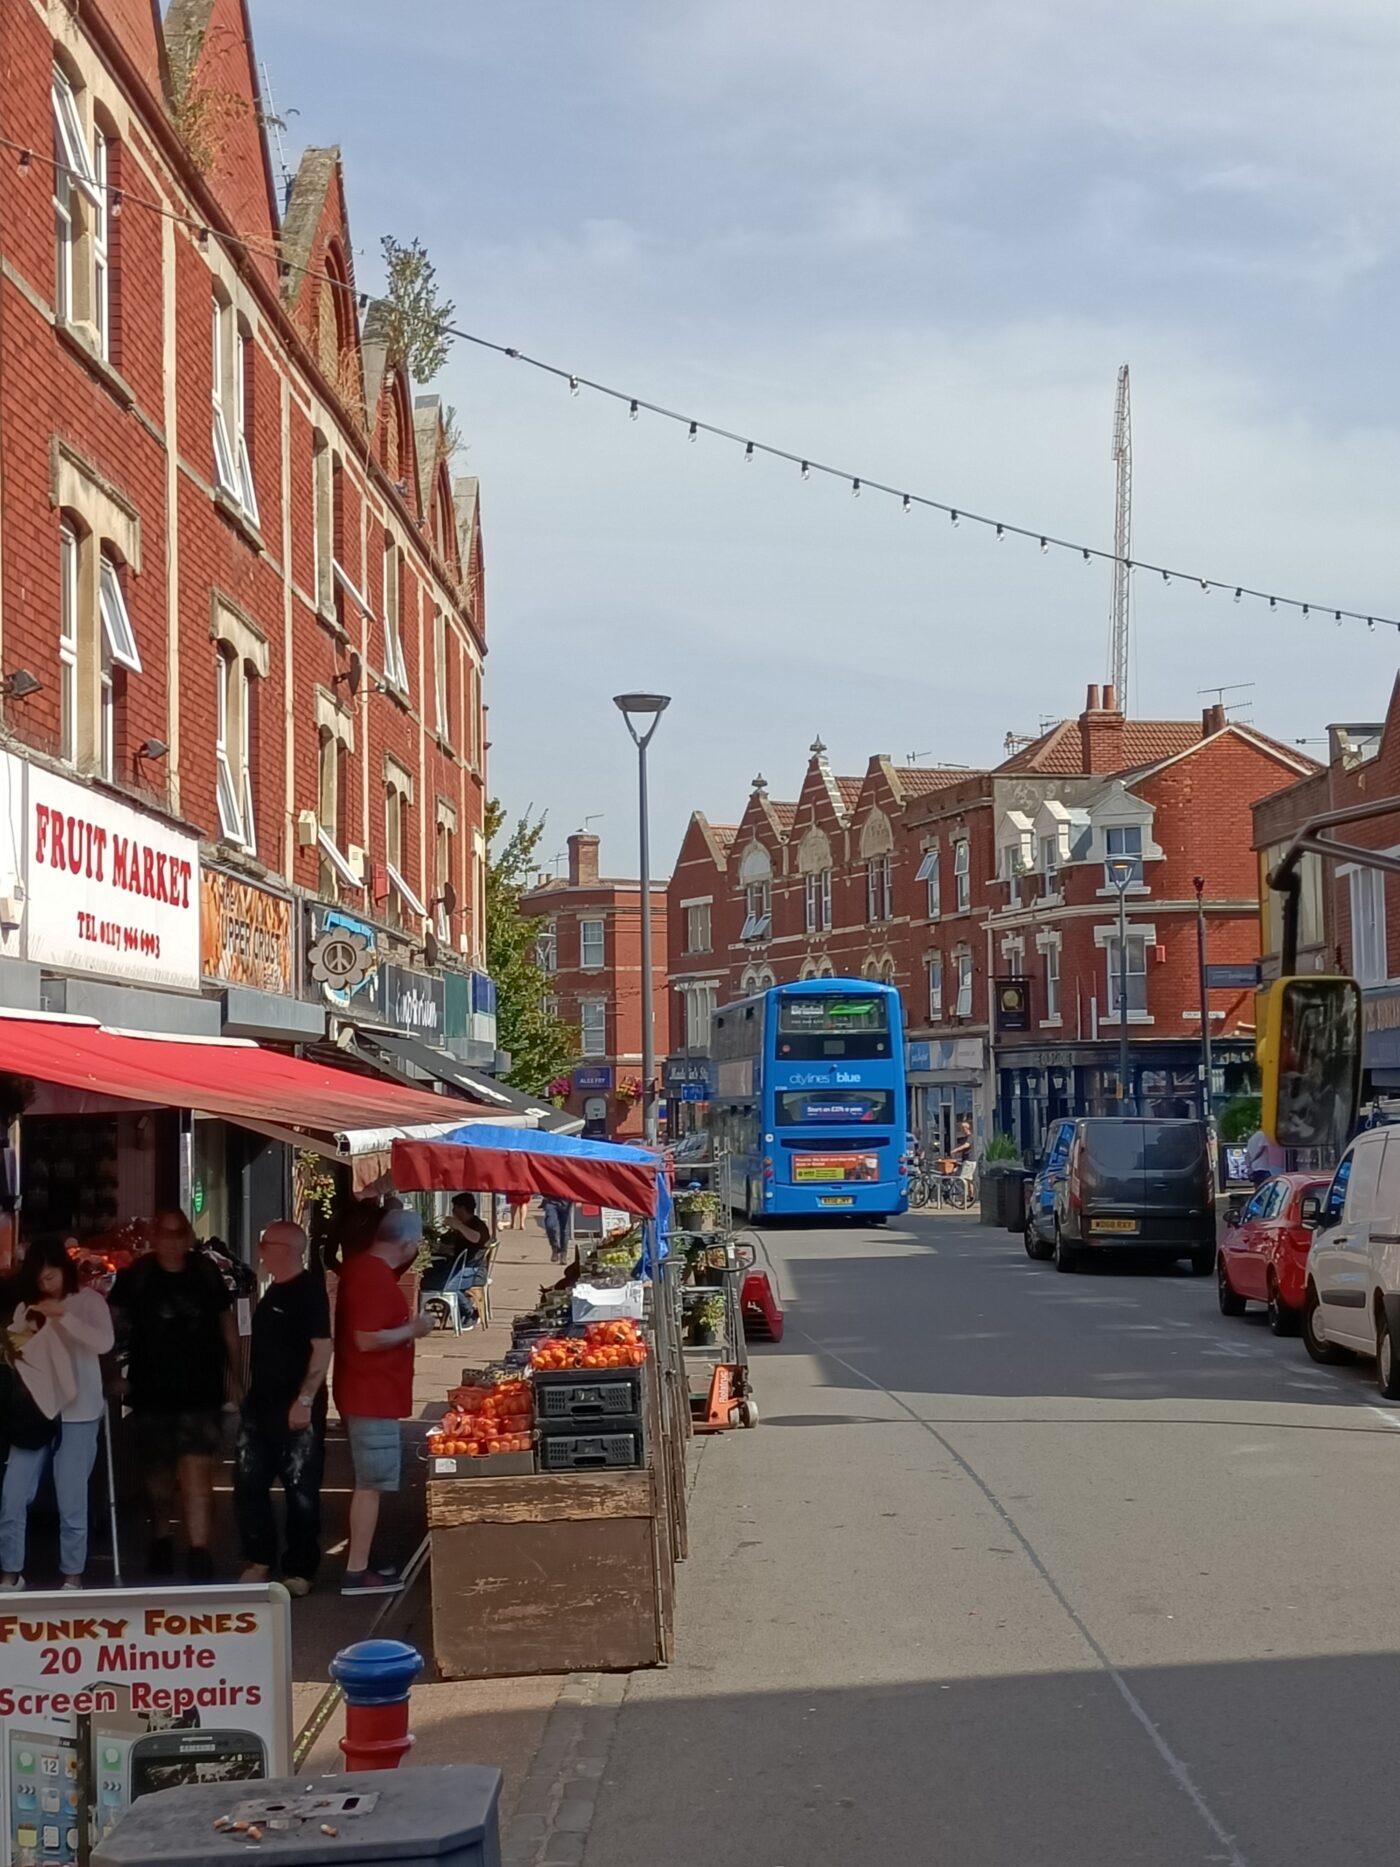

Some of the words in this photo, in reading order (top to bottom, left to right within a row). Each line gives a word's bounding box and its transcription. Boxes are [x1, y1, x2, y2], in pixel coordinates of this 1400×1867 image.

[35, 803, 106, 882] FRUIT
[112, 833, 192, 909] MARKET
[77, 910, 97, 942] TEL
[100, 920, 121, 951] 0117
[124, 926, 138, 952] 966
[140, 929, 160, 959] 6903
[222, 913, 252, 957] UPPER
[254, 924, 281, 964] CRUST
[789, 1073, 830, 1085] citylines
[836, 1072, 861, 1083] blue
[0, 1615, 128, 1643] FUNKY
[144, 1609, 258, 1637] FONES
[40, 1646, 82, 1675] 20
[97, 1643, 216, 1672] Minute
[0, 1687, 116, 1716] Screen
[131, 1678, 262, 1717] Repairs
[42, 1759, 57, 1773] 12
